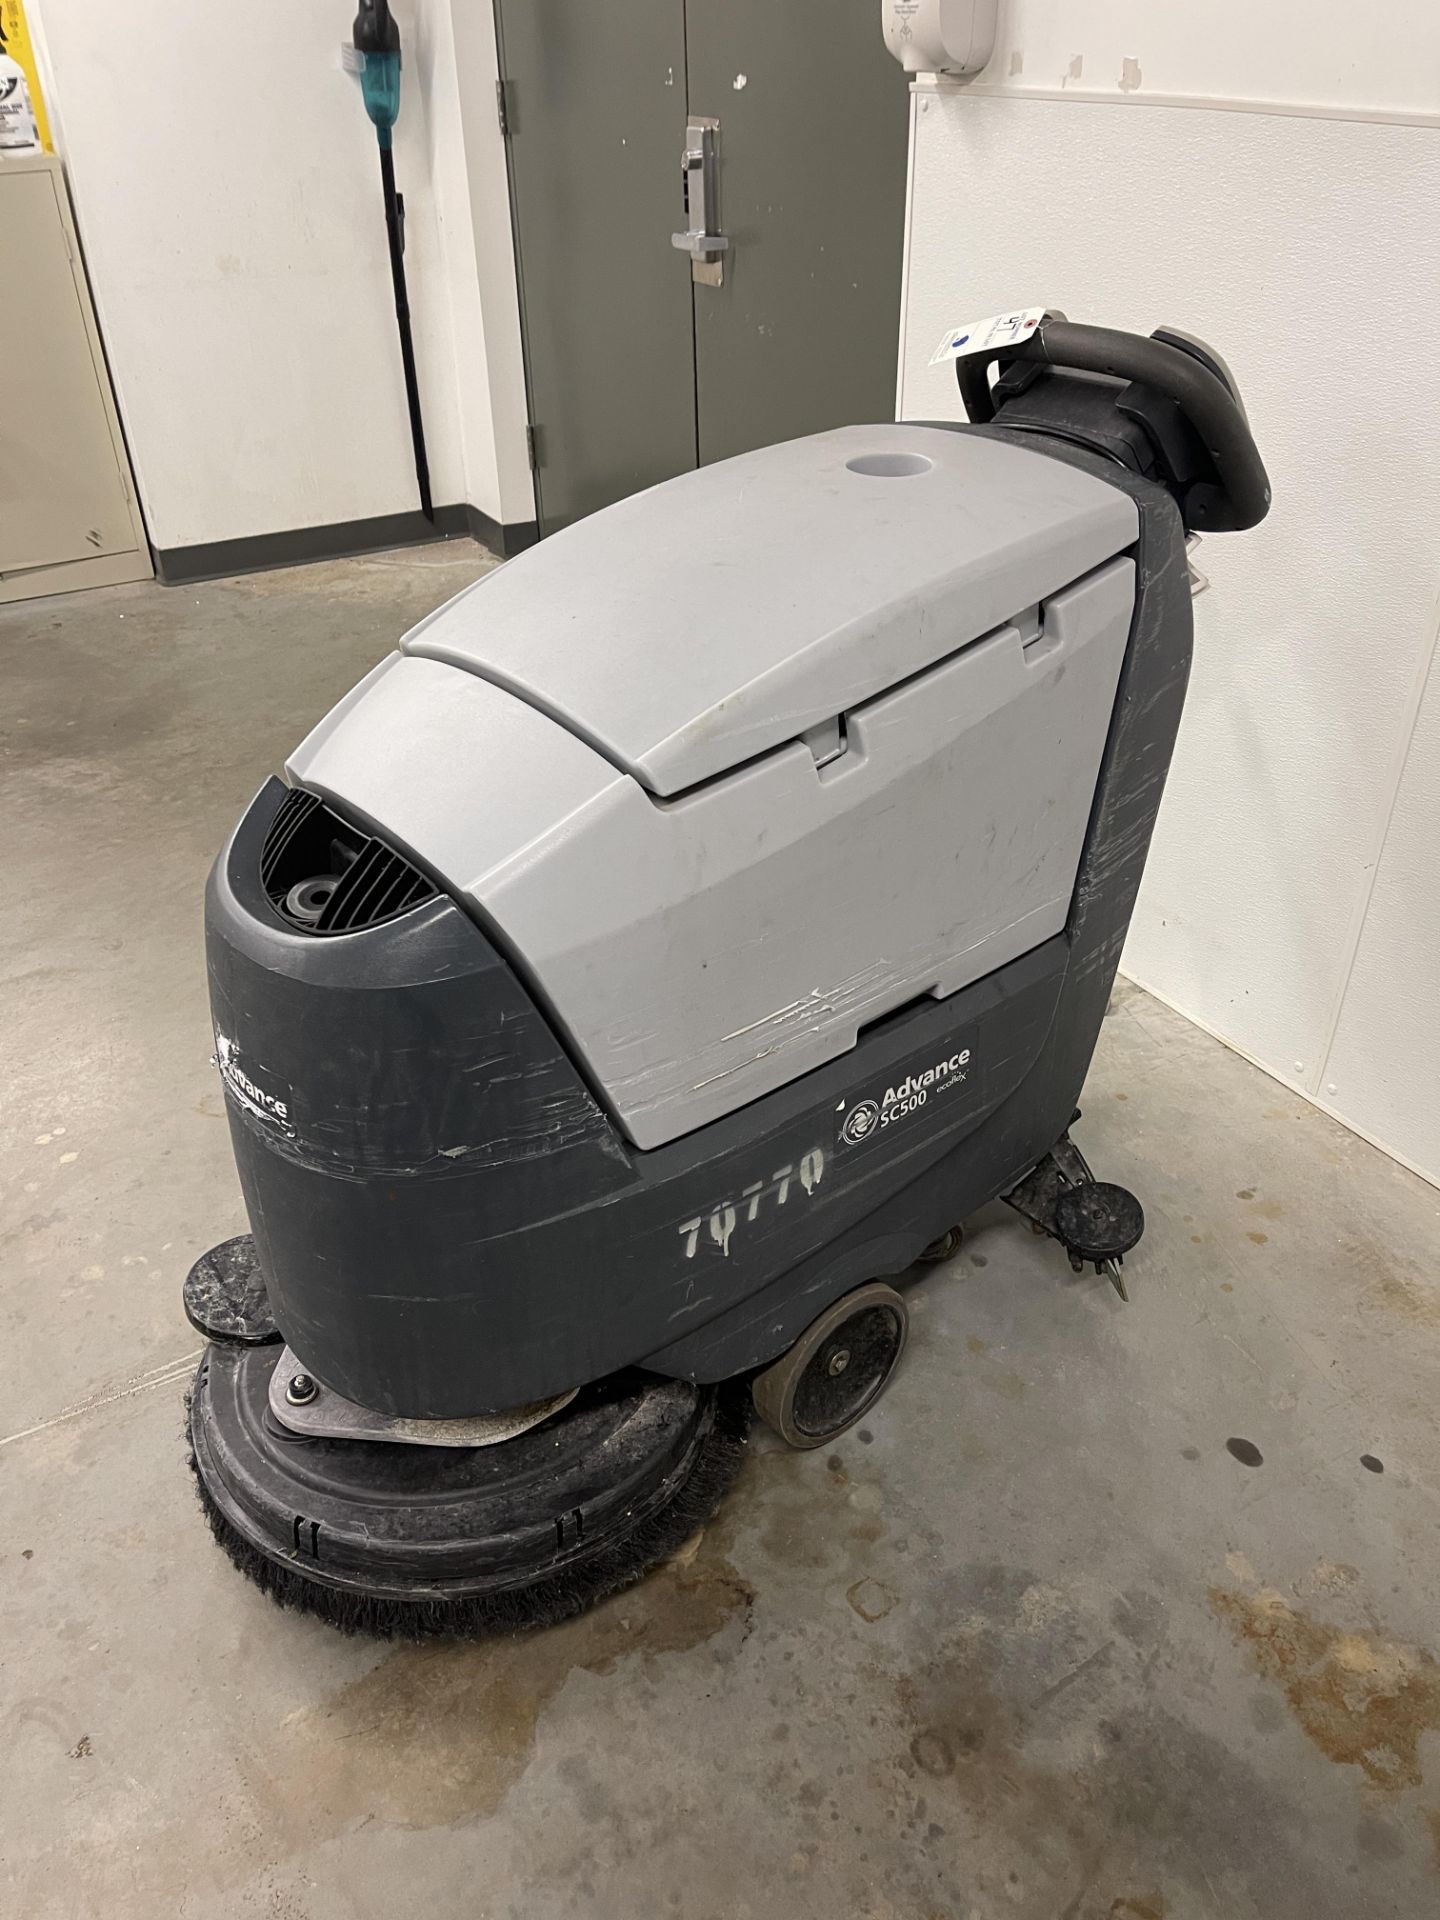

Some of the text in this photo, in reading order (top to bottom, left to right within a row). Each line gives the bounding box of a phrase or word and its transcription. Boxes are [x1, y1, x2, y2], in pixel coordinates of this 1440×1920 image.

[882, 1048, 971, 1108] Advance
[880, 1090, 927, 1128] SC500
[678, 1148, 824, 1258] 70770
